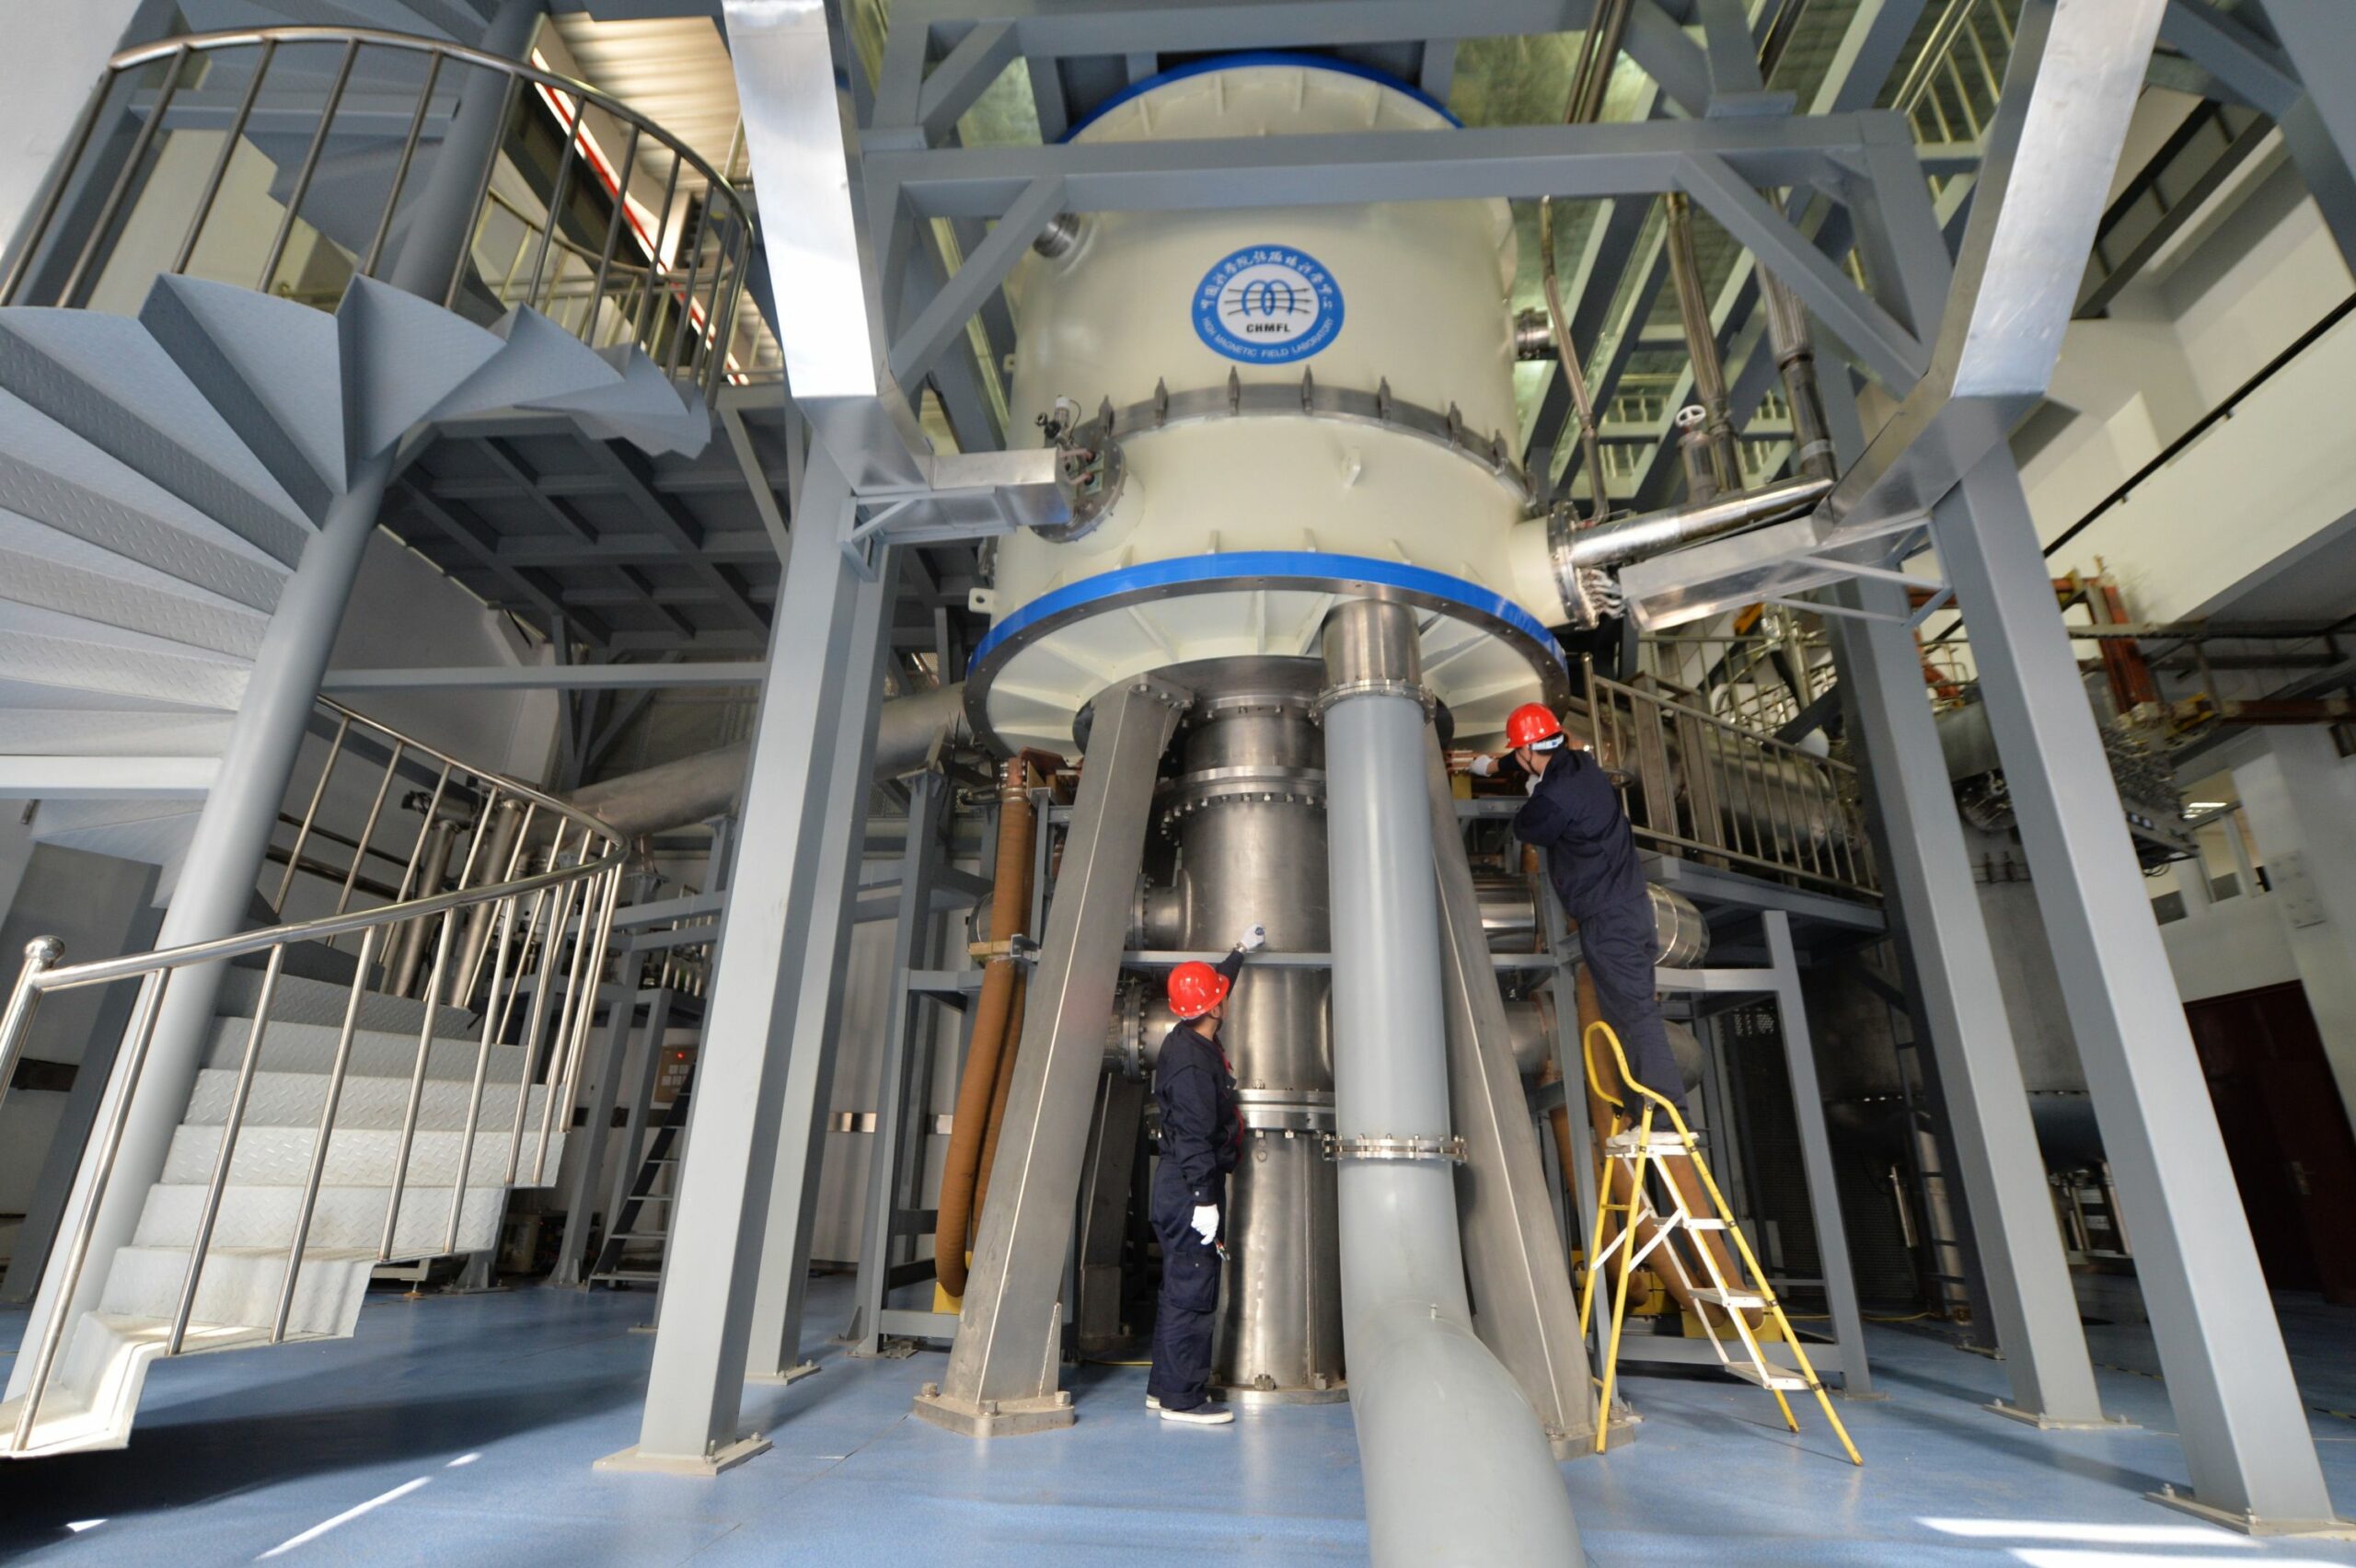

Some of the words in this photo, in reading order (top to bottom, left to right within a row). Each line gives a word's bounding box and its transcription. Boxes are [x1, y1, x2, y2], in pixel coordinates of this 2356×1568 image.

[1202, 317, 1216, 337] HIGH
[1215, 334, 1257, 357] MAGNETIC
[1261, 349, 1288, 358] FIELD
[1291, 317, 1334, 354] LABORATORY
[1246, 323, 1290, 333] CHMFL
